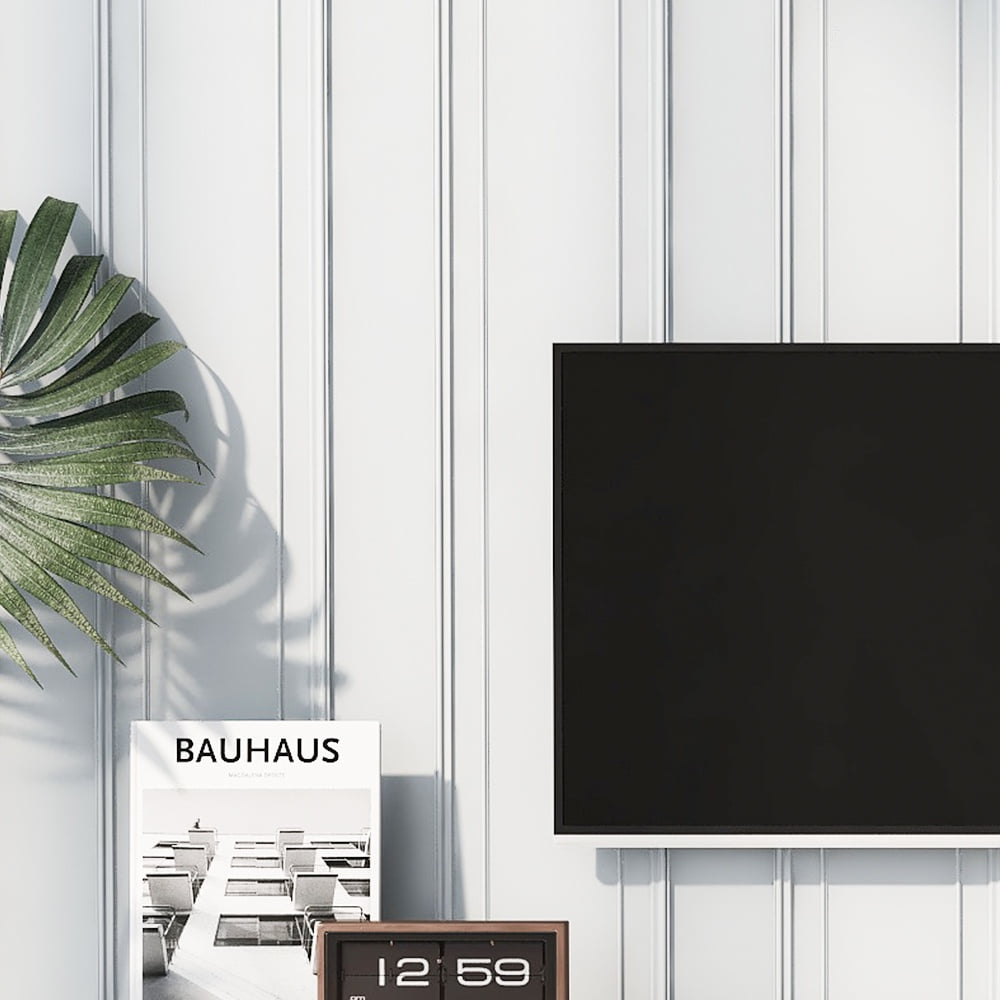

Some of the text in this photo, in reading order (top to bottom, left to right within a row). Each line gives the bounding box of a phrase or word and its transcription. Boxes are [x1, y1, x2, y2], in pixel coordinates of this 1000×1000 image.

[176, 738, 340, 763] BAUHAUS
[378, 957, 531, 987] 12 59
